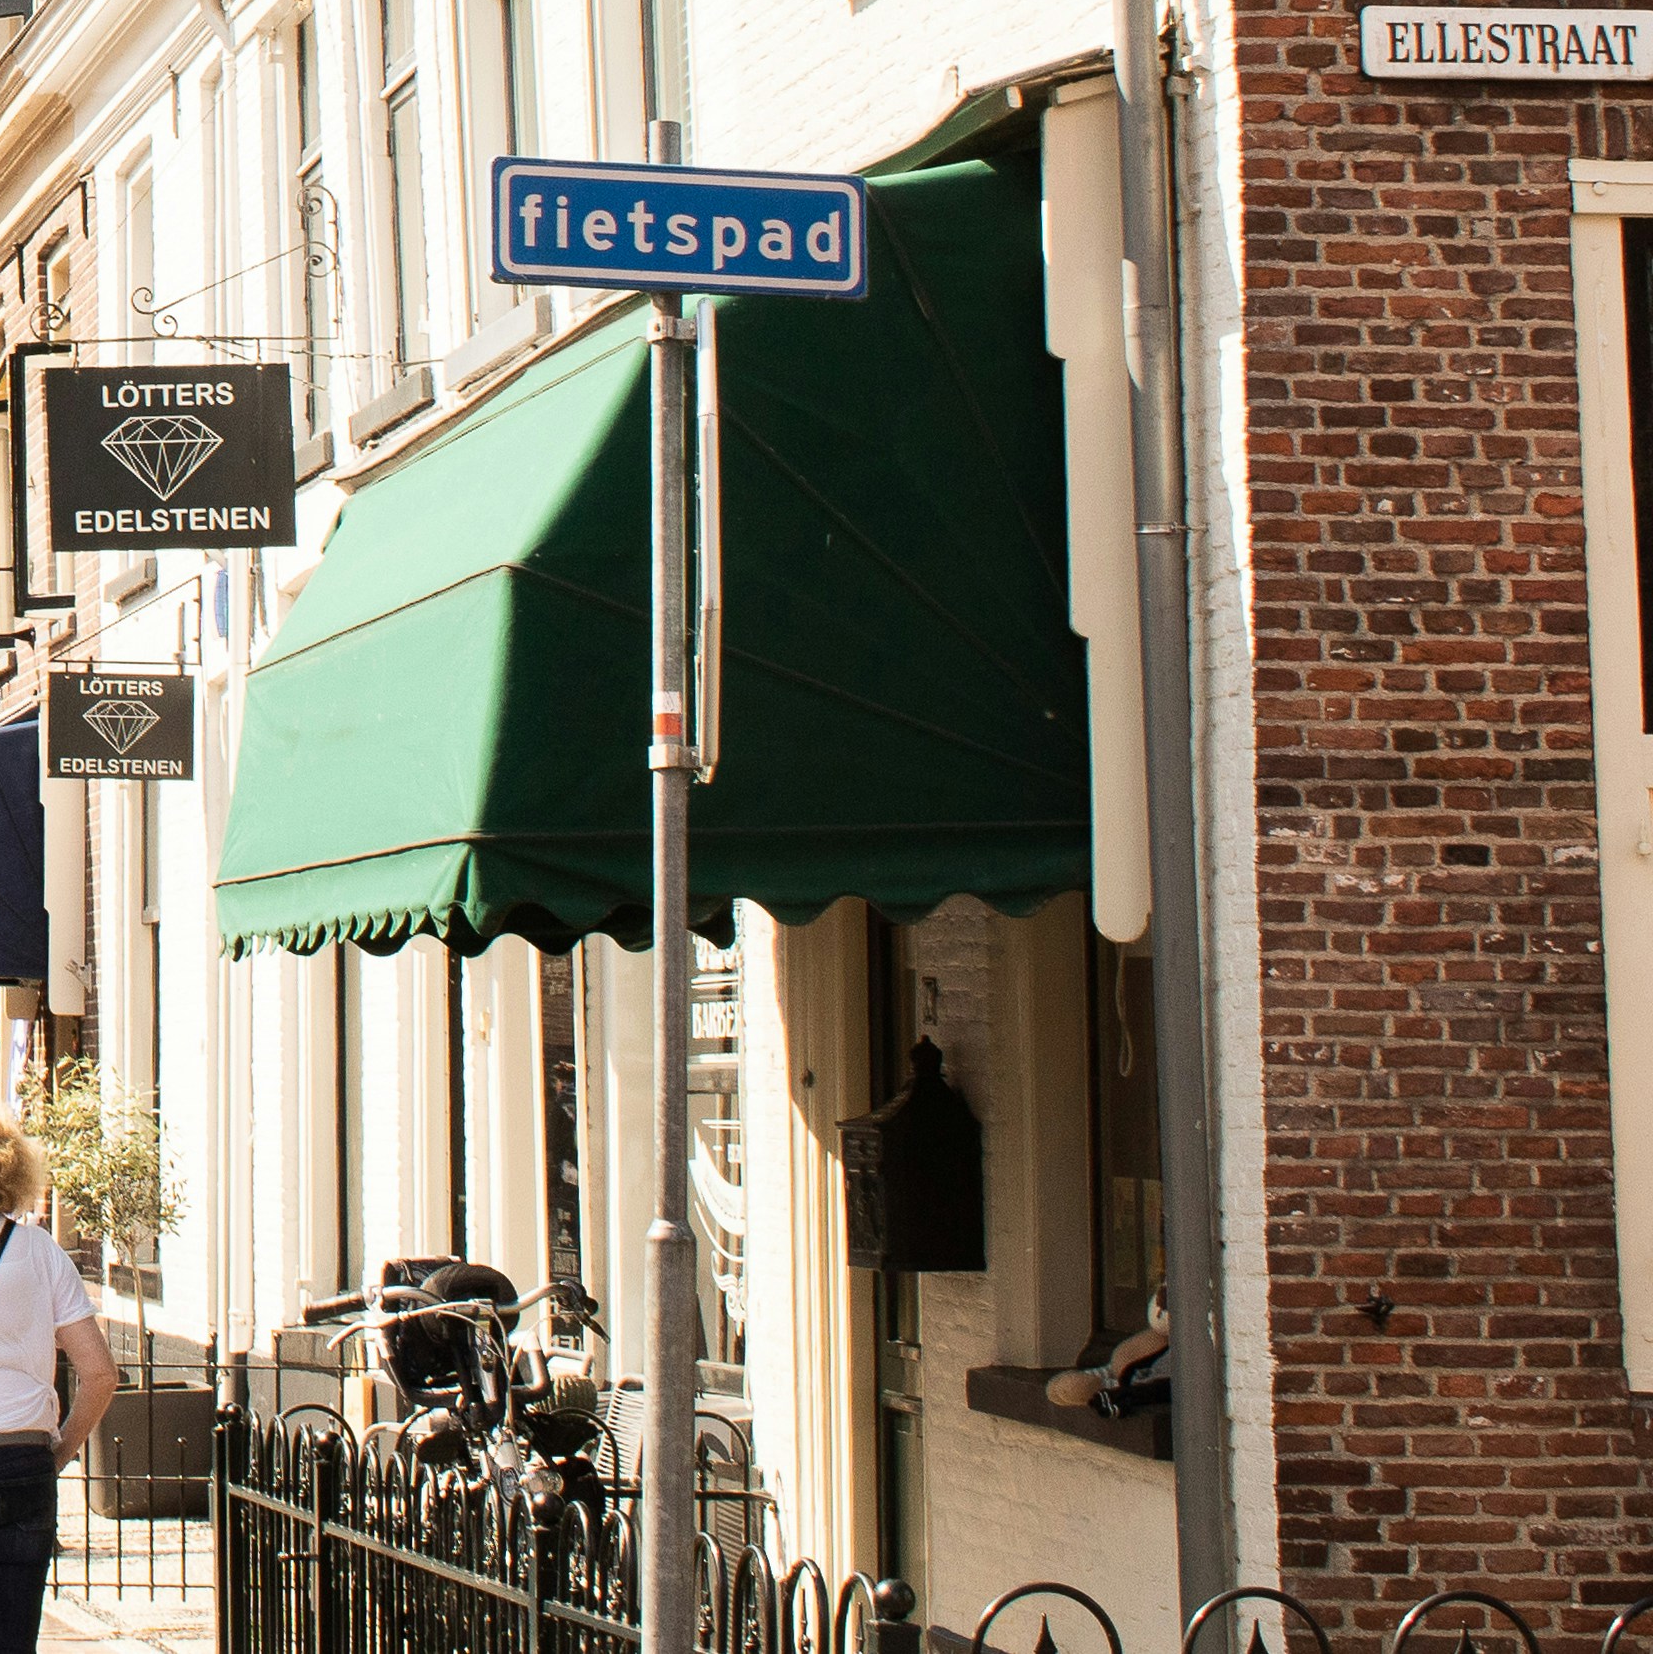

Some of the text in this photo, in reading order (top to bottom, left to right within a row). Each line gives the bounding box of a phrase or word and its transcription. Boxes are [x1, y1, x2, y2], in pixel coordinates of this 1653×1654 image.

[1385, 21, 1637, 66] ELLESTRAAT
[519, 193, 841, 271] fietspad
[101, 380, 235, 409] LÖTTERS
[74, 506, 272, 534] EDELSTENEN
[79, 676, 164, 697] LÖTTERS
[59, 757, 184, 777] EDELSTENEN
